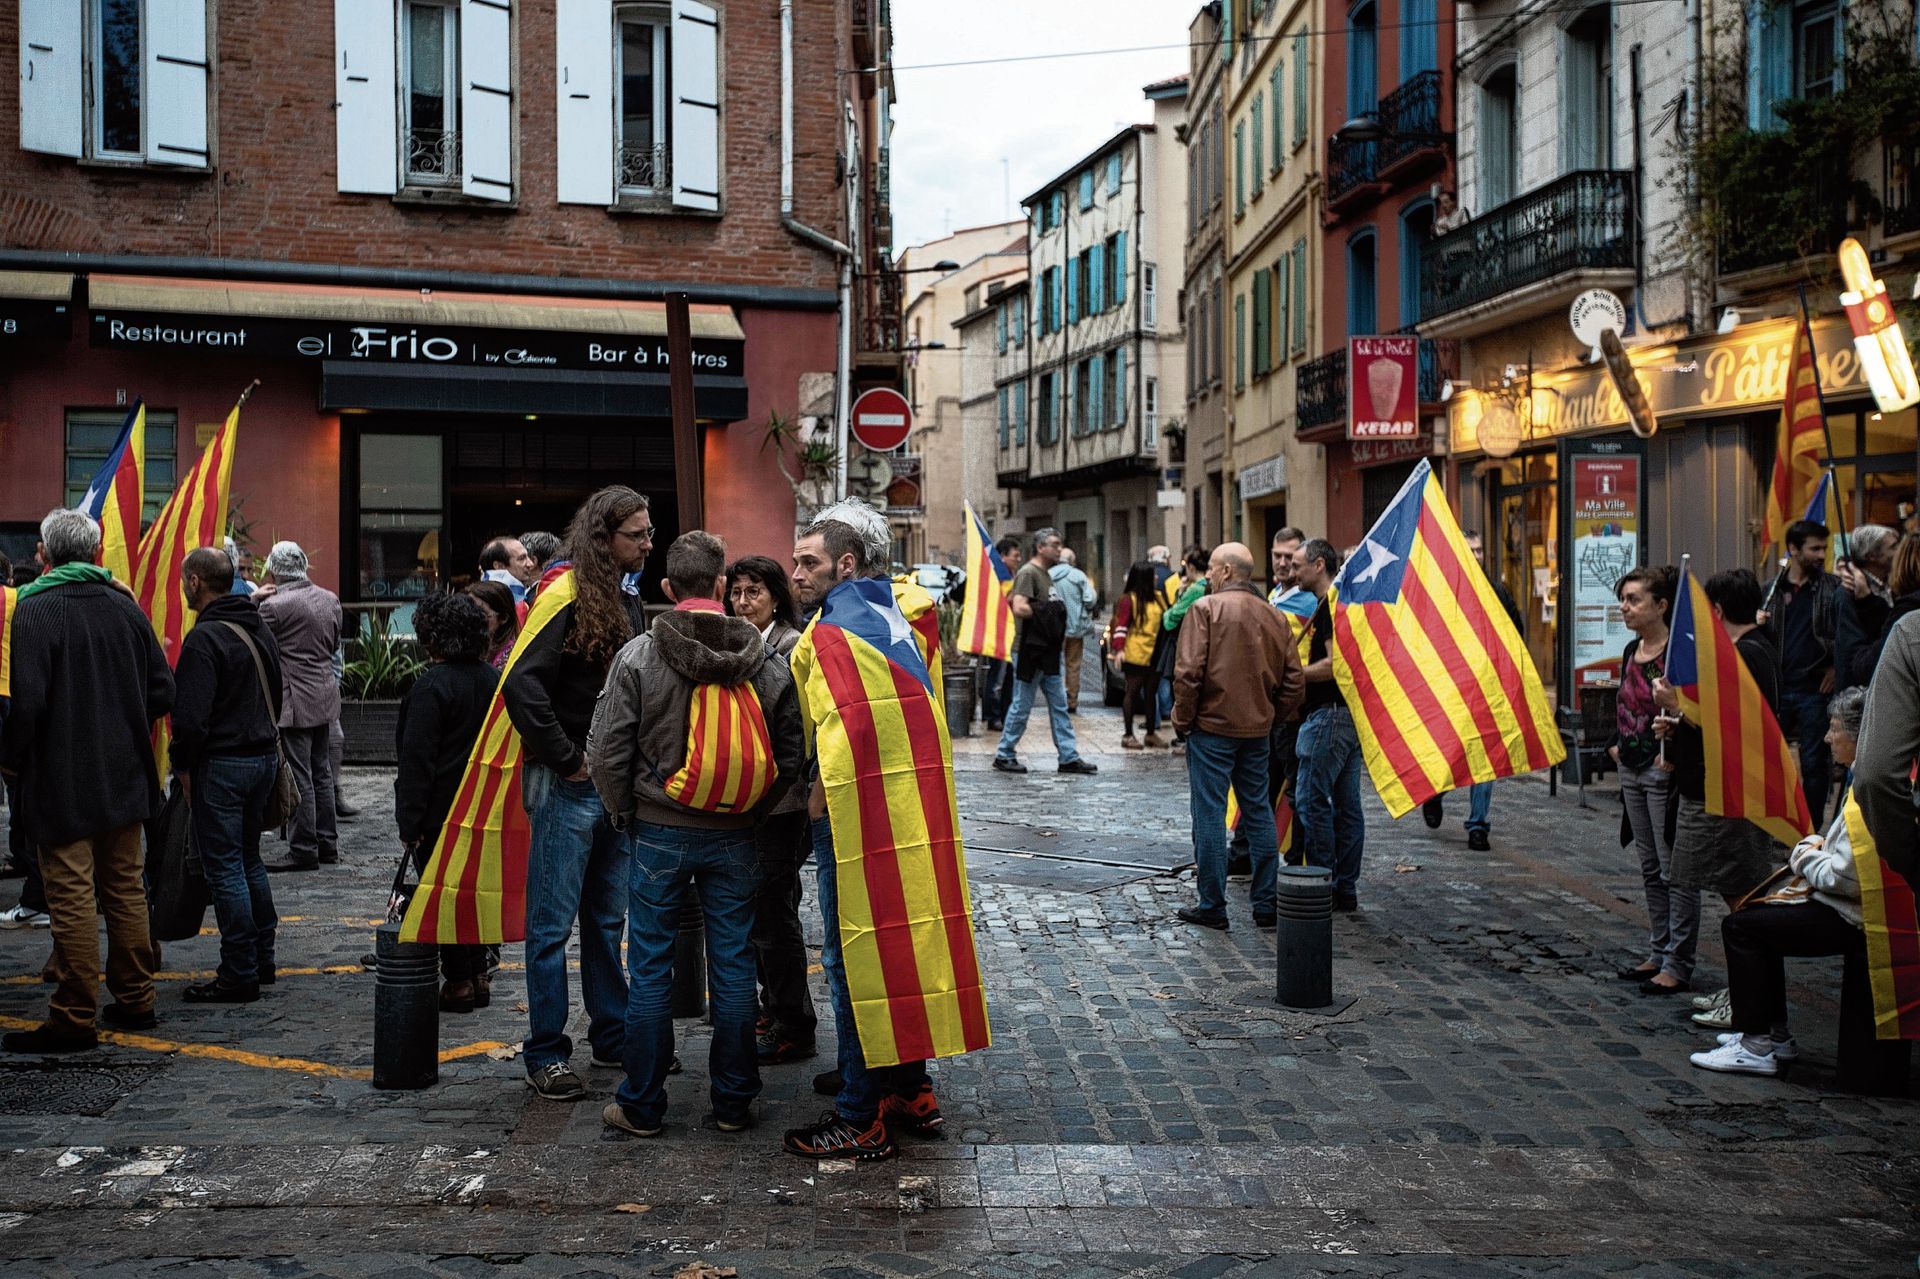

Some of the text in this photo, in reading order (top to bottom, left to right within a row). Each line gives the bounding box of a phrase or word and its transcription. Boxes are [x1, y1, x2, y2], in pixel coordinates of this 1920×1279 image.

[111, 319, 247, 346] Restaurant
[350, 326, 458, 361] Frio
[485, 354, 500, 363] by
[589, 343, 728, 368] Bar à htres
[1355, 421, 1415, 435] KEBAB
[1585, 499, 1626, 511] Ma Ville
